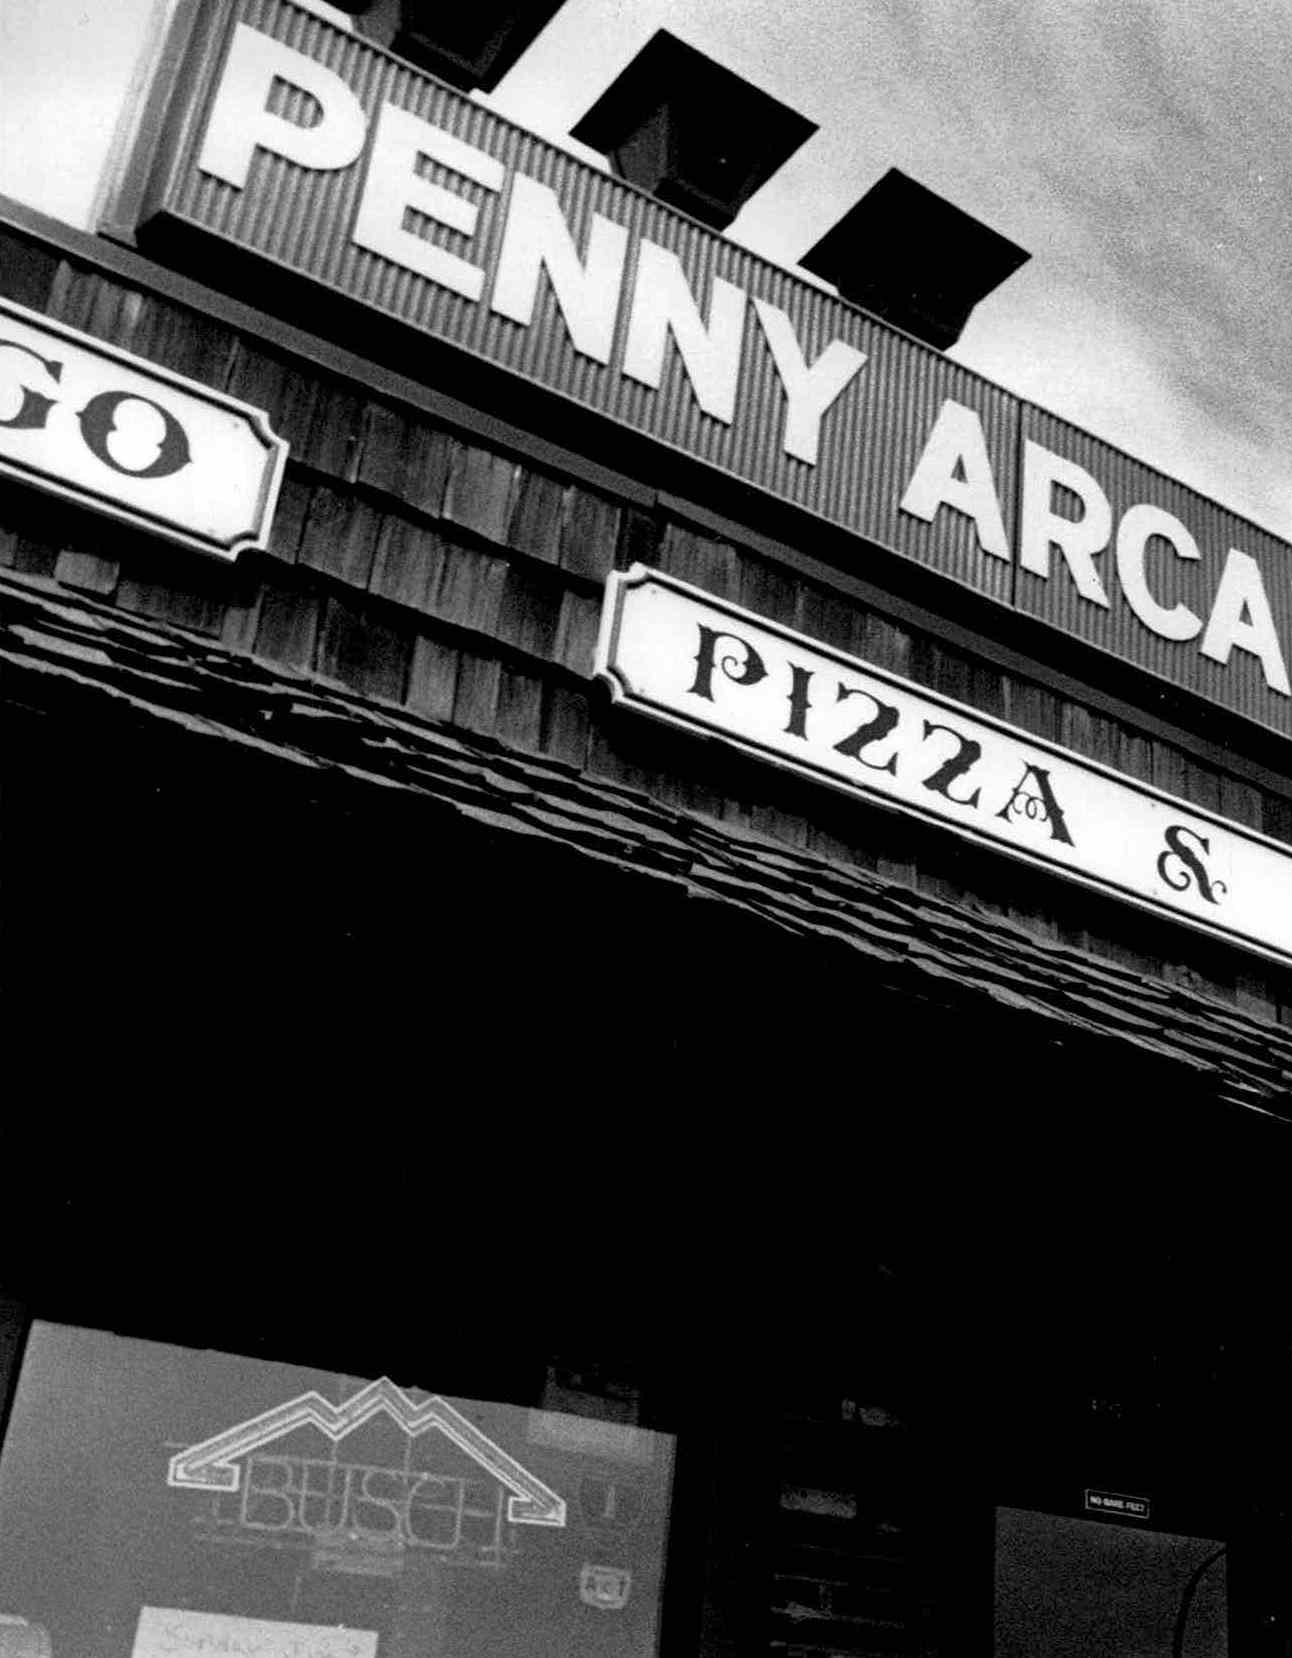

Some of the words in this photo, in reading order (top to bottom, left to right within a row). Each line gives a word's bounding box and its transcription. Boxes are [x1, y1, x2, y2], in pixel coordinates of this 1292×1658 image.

[199, 22, 867, 467] PENNY
[687, 622, 1075, 847] PIZZA
[1156, 824, 1227, 904] &
[1090, 1496, 1102, 1506] NO
